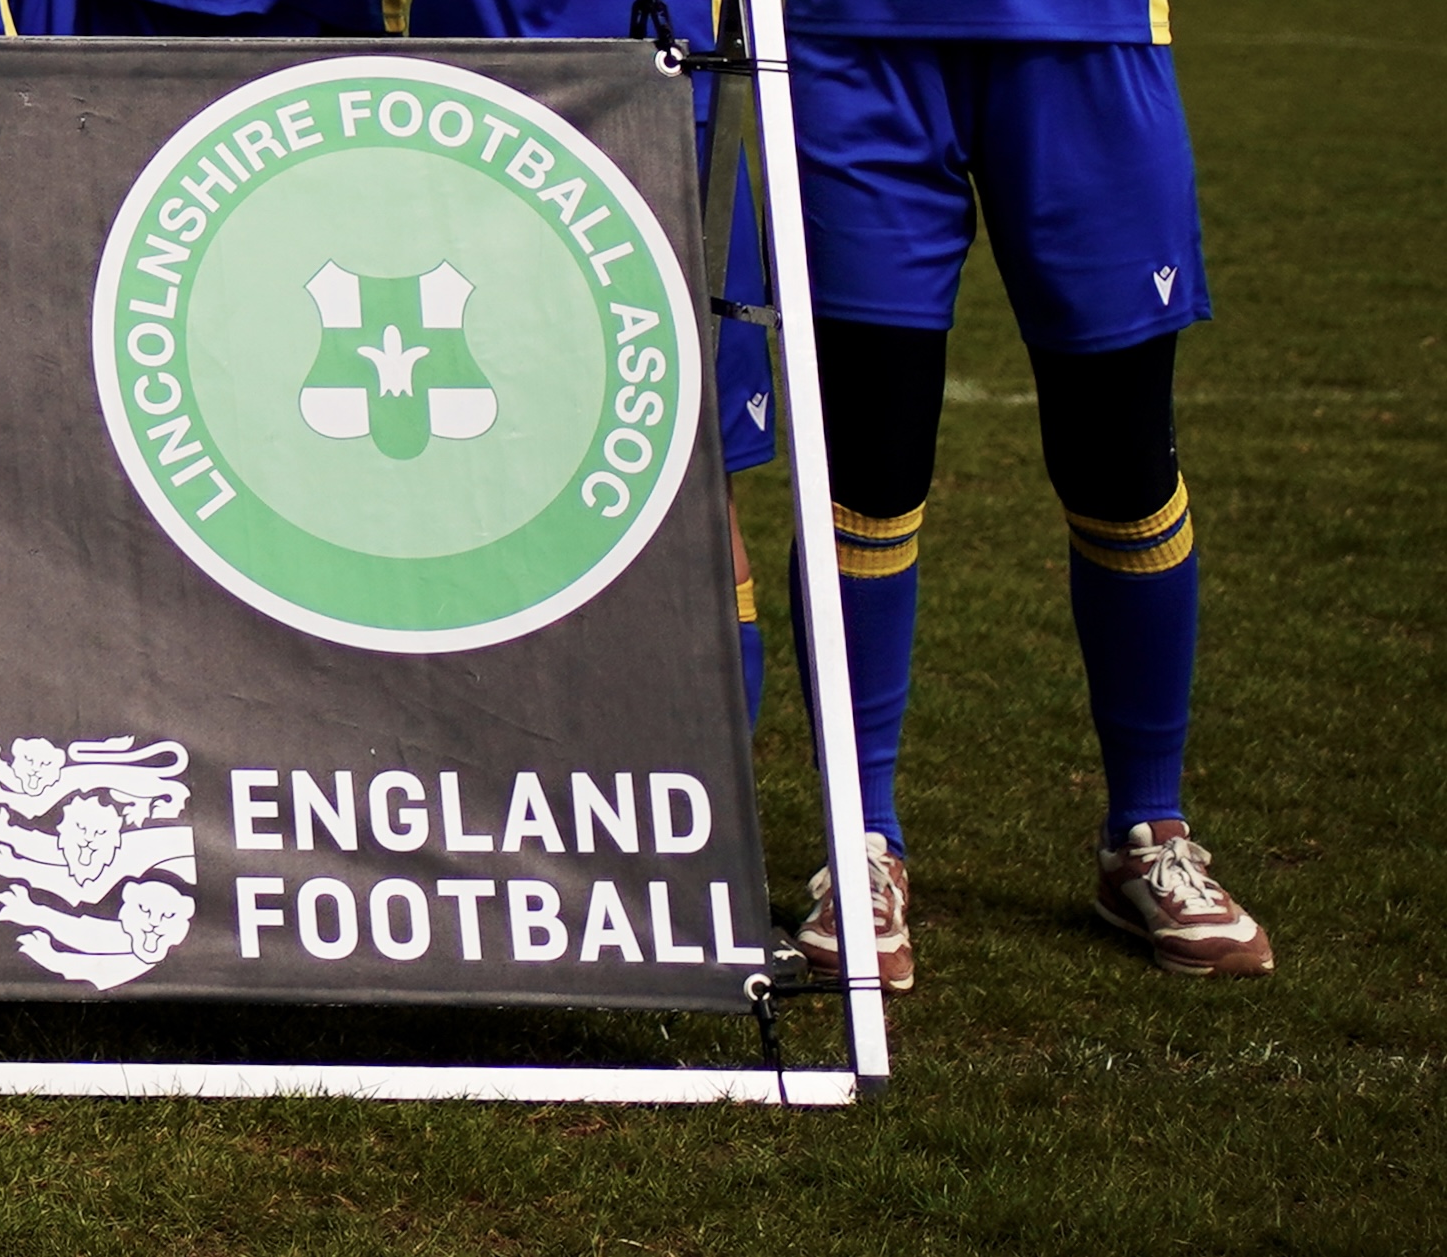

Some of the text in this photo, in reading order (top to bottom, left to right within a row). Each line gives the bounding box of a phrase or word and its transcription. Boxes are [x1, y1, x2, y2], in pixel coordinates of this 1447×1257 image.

[126, 90, 667, 523] LINCOLNSHIRE FOOTBALL ASSOC
[230, 769, 712, 854] ENGLAND
[236, 877, 765, 965] FOOTBALL
